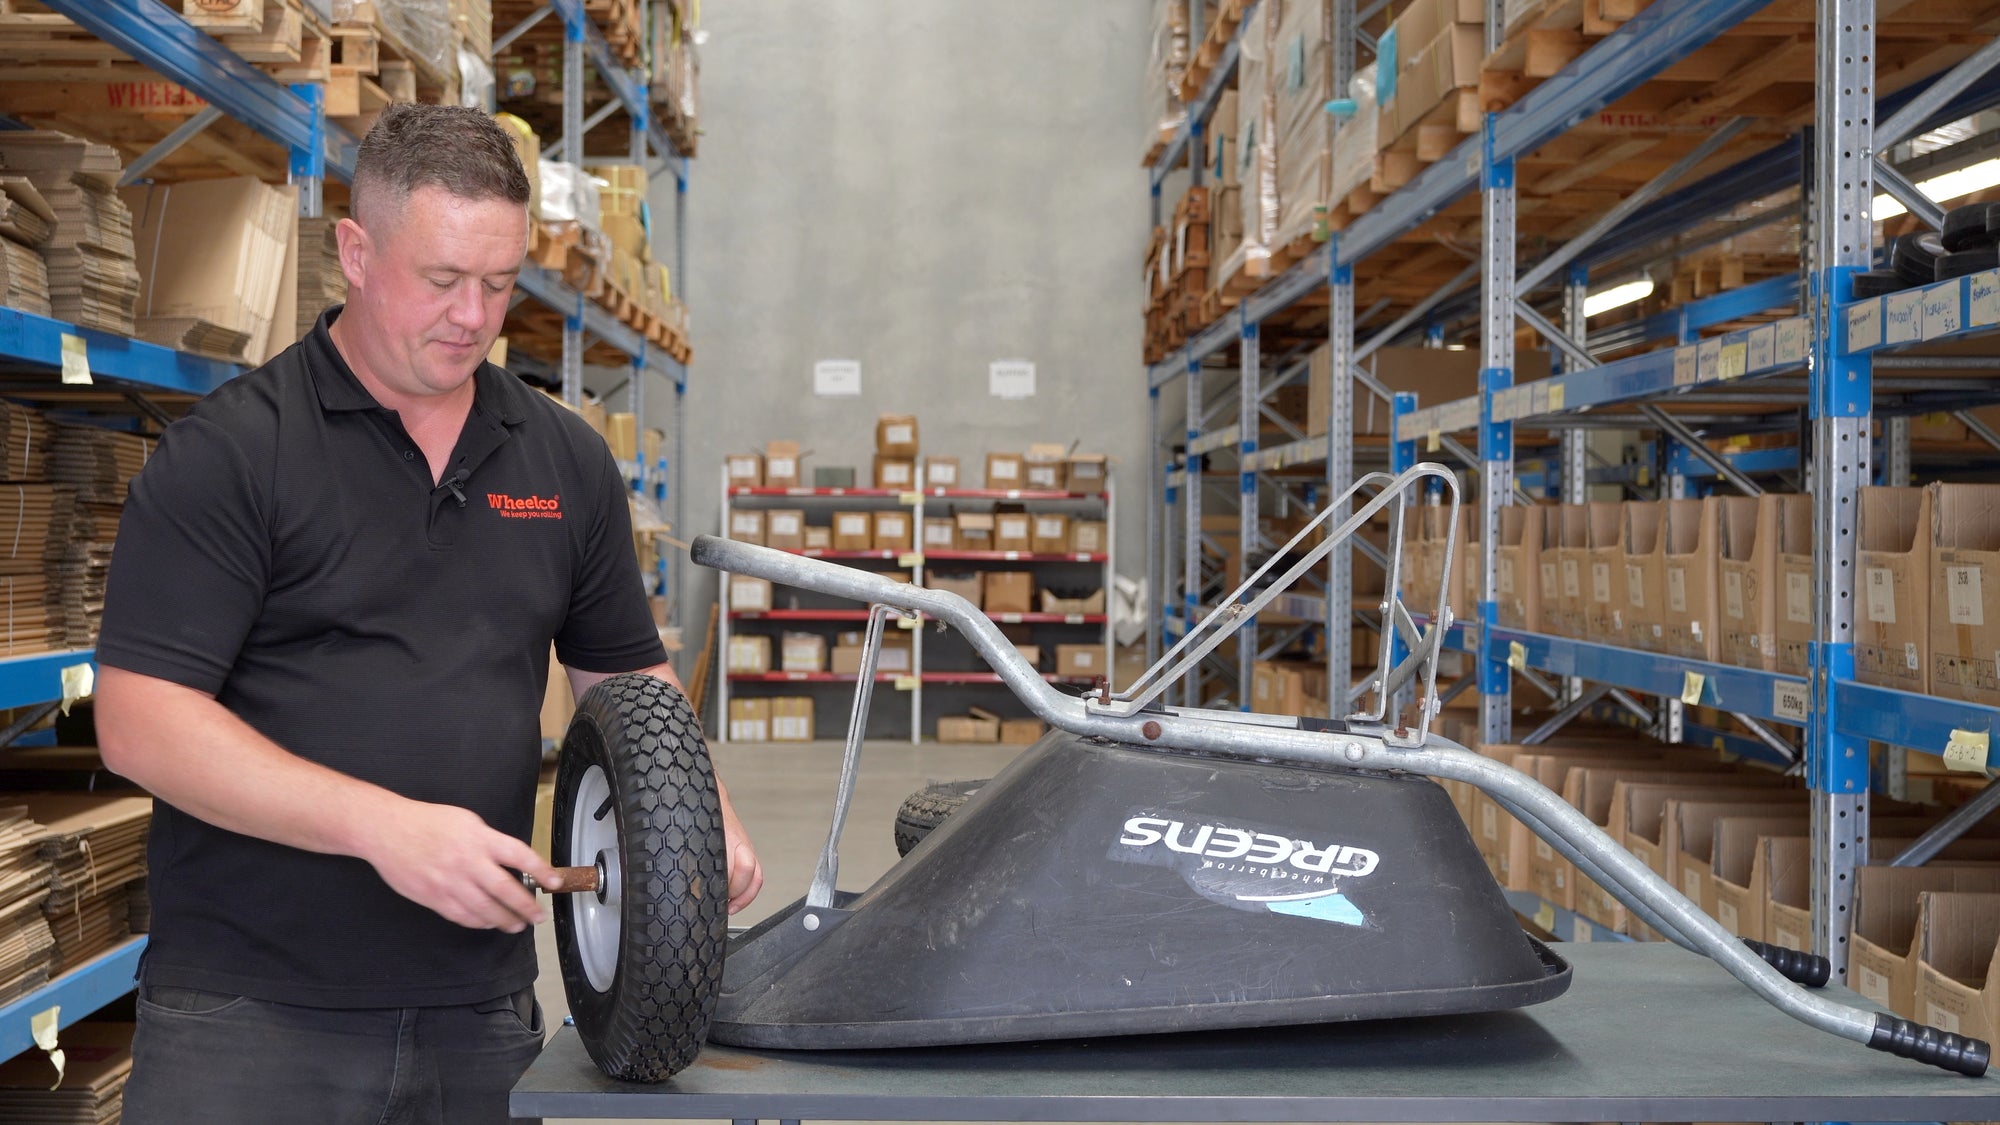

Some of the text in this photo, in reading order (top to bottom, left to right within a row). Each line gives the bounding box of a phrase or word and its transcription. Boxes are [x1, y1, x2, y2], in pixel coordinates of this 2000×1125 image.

[487, 493, 559, 510] Wheelco
[500, 510, 562, 520] We keep you rolling
[1782, 693, 1803, 714] 650kg
